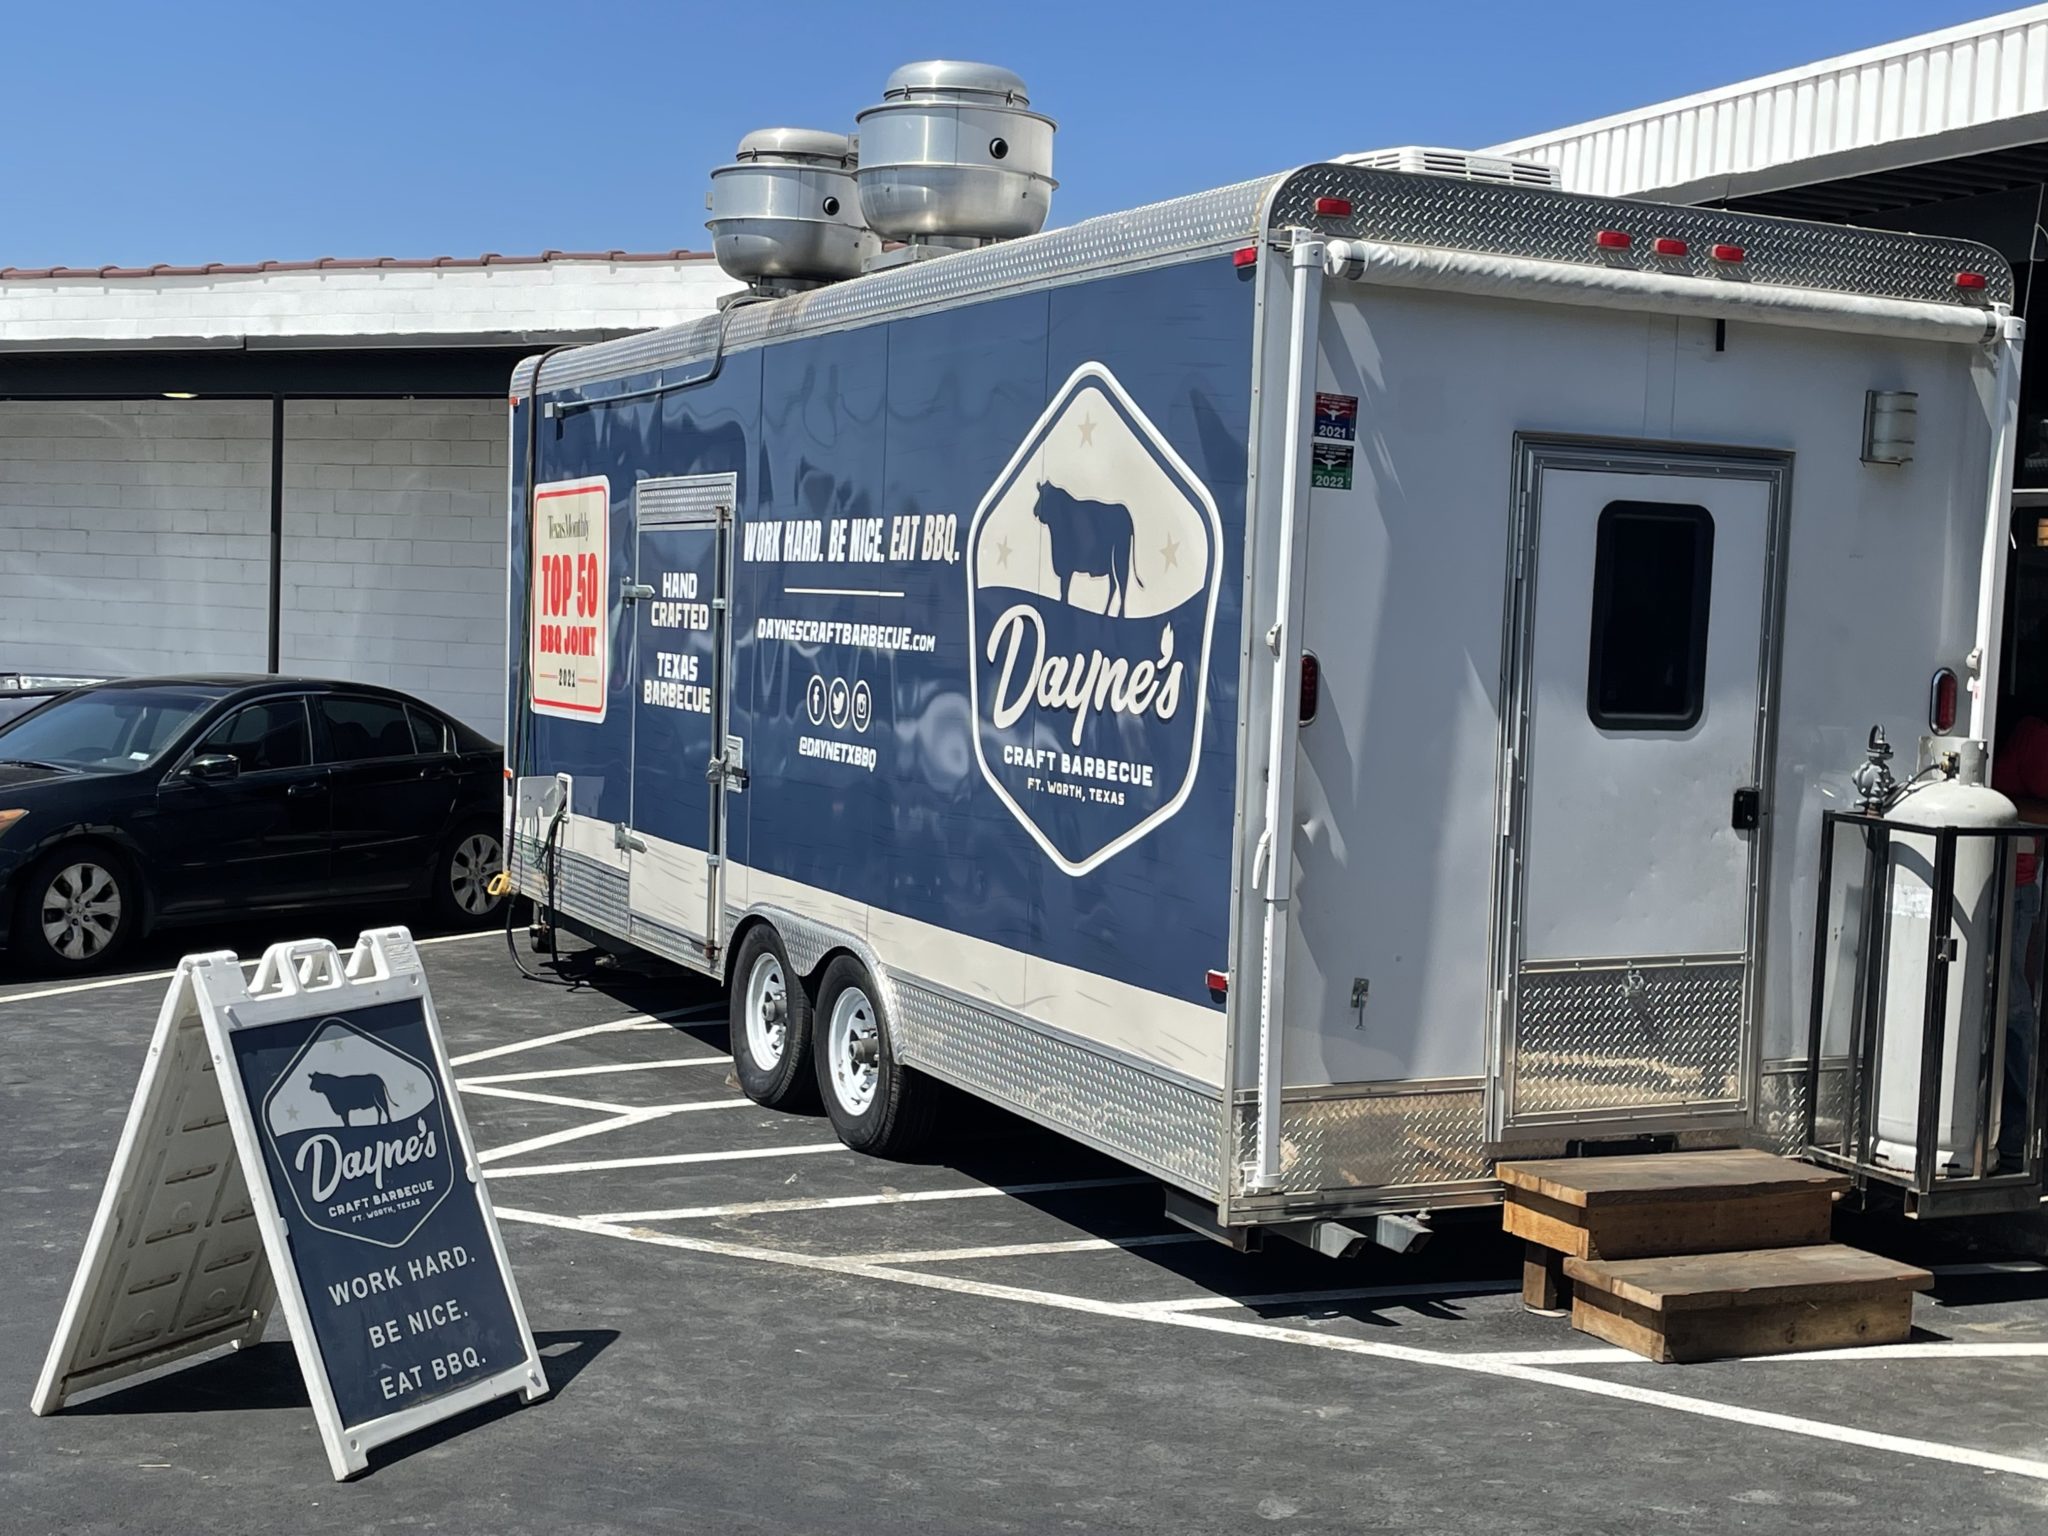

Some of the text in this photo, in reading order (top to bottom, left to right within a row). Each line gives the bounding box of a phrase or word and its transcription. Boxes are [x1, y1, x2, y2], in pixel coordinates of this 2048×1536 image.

[1319, 425, 1347, 438] 2021
[1315, 475, 1344, 487] 2022
[743, 514, 960, 564] WORK HARD. BE NICE. EAT BBQ.
[541, 553, 598, 618] TOP 50
[662, 572, 697, 599] HAND
[651, 601, 709, 630] CRAFTED
[540, 625, 597, 657] BBQ JOINT
[558, 668, 576, 688] 2021
[657, 652, 698, 681] TEXAS
[987, 604, 1184, 747] Dayne's
[643, 679, 711, 714] BARBECUE
[798, 736, 877, 772] @DAYNETXBBQ
[1003, 745, 1153, 787] CRAFT BARBECUE
[1027, 777, 1125, 806] FT. WORTH, TEXAS
[295, 1117, 437, 1202] Dayne's
[328, 1180, 435, 1217] CRAFT BARBECUE
[396, 1198, 421, 1210] TEXAS
[328, 1245, 476, 1307] WORK HARD.
[368, 1299, 469, 1349] BE NICE.
[380, 1346, 487, 1400] EAT BBQ.
